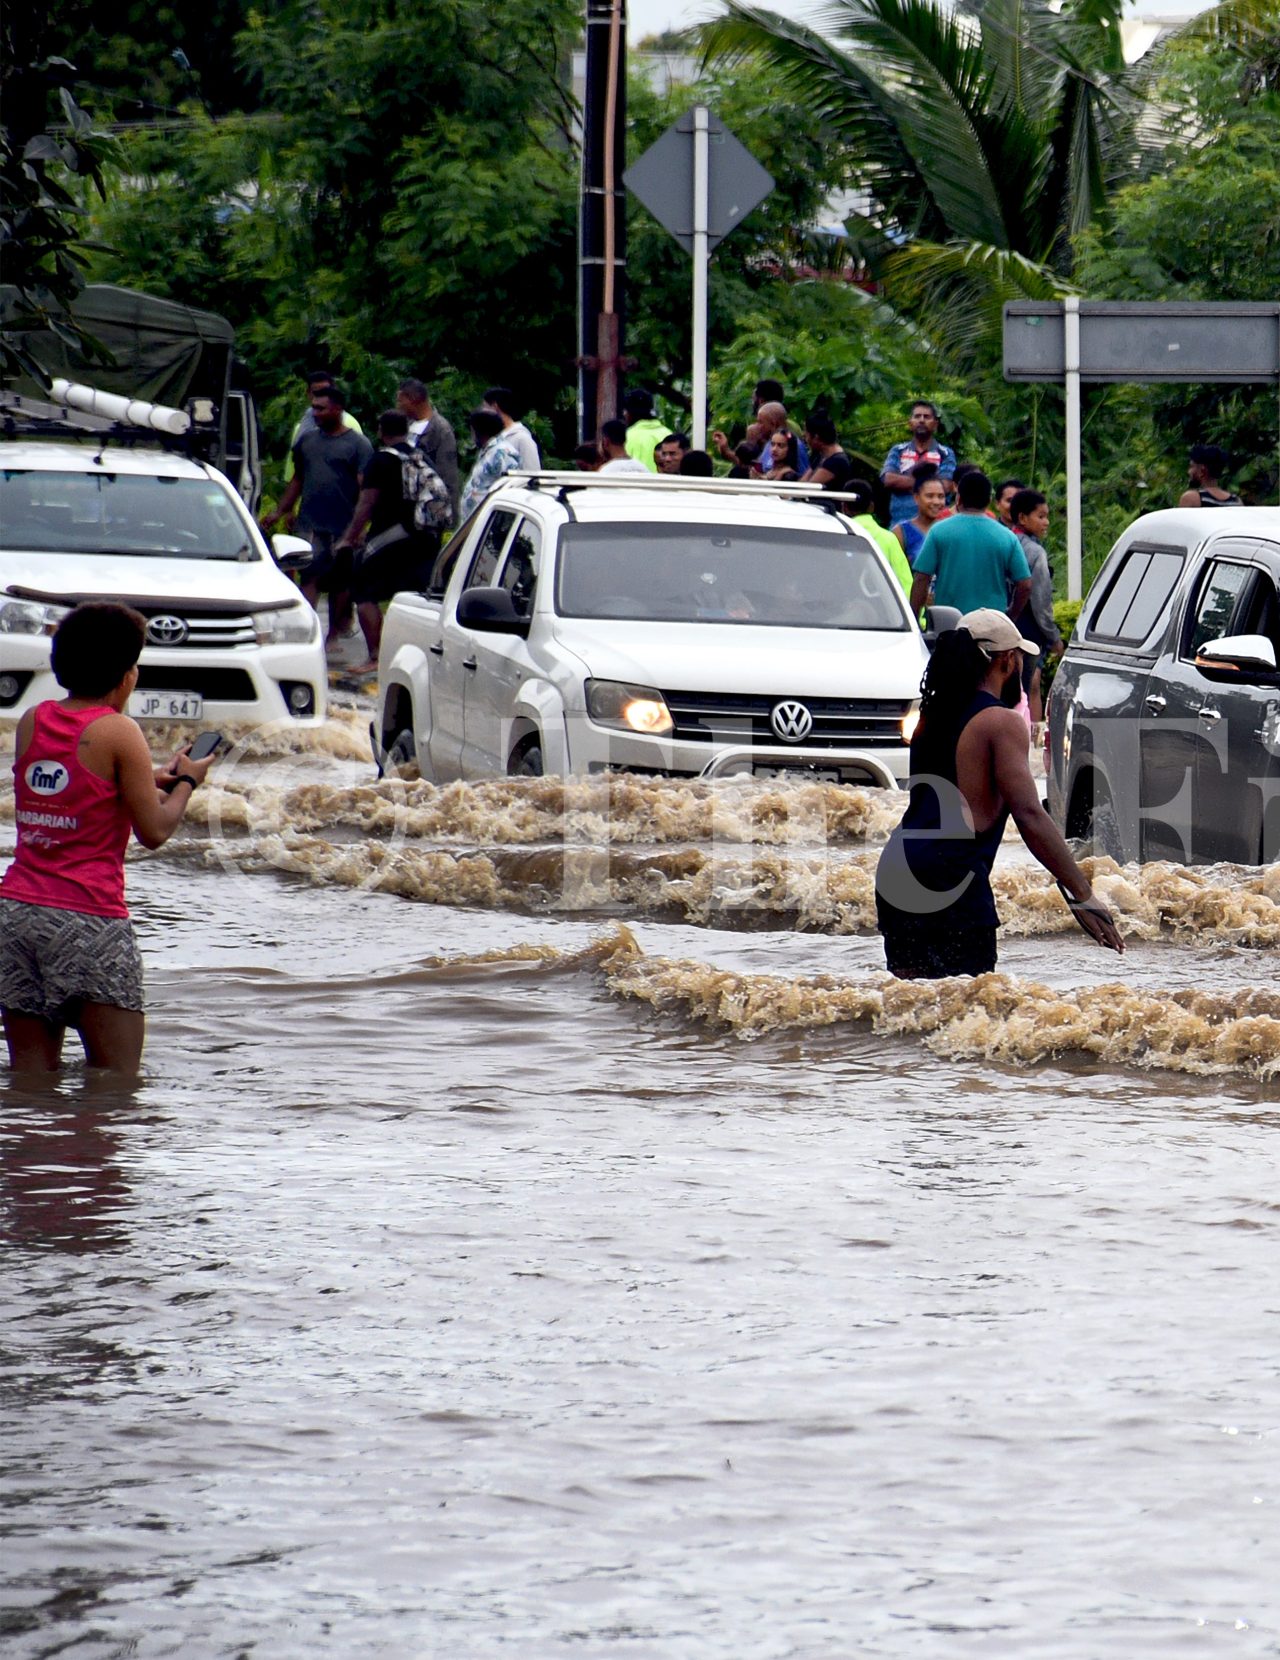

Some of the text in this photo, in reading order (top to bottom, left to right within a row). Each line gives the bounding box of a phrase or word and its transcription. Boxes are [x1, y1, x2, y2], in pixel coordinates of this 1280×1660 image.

[141, 699, 199, 716] JP 647
[31, 766, 63, 789] fmf
